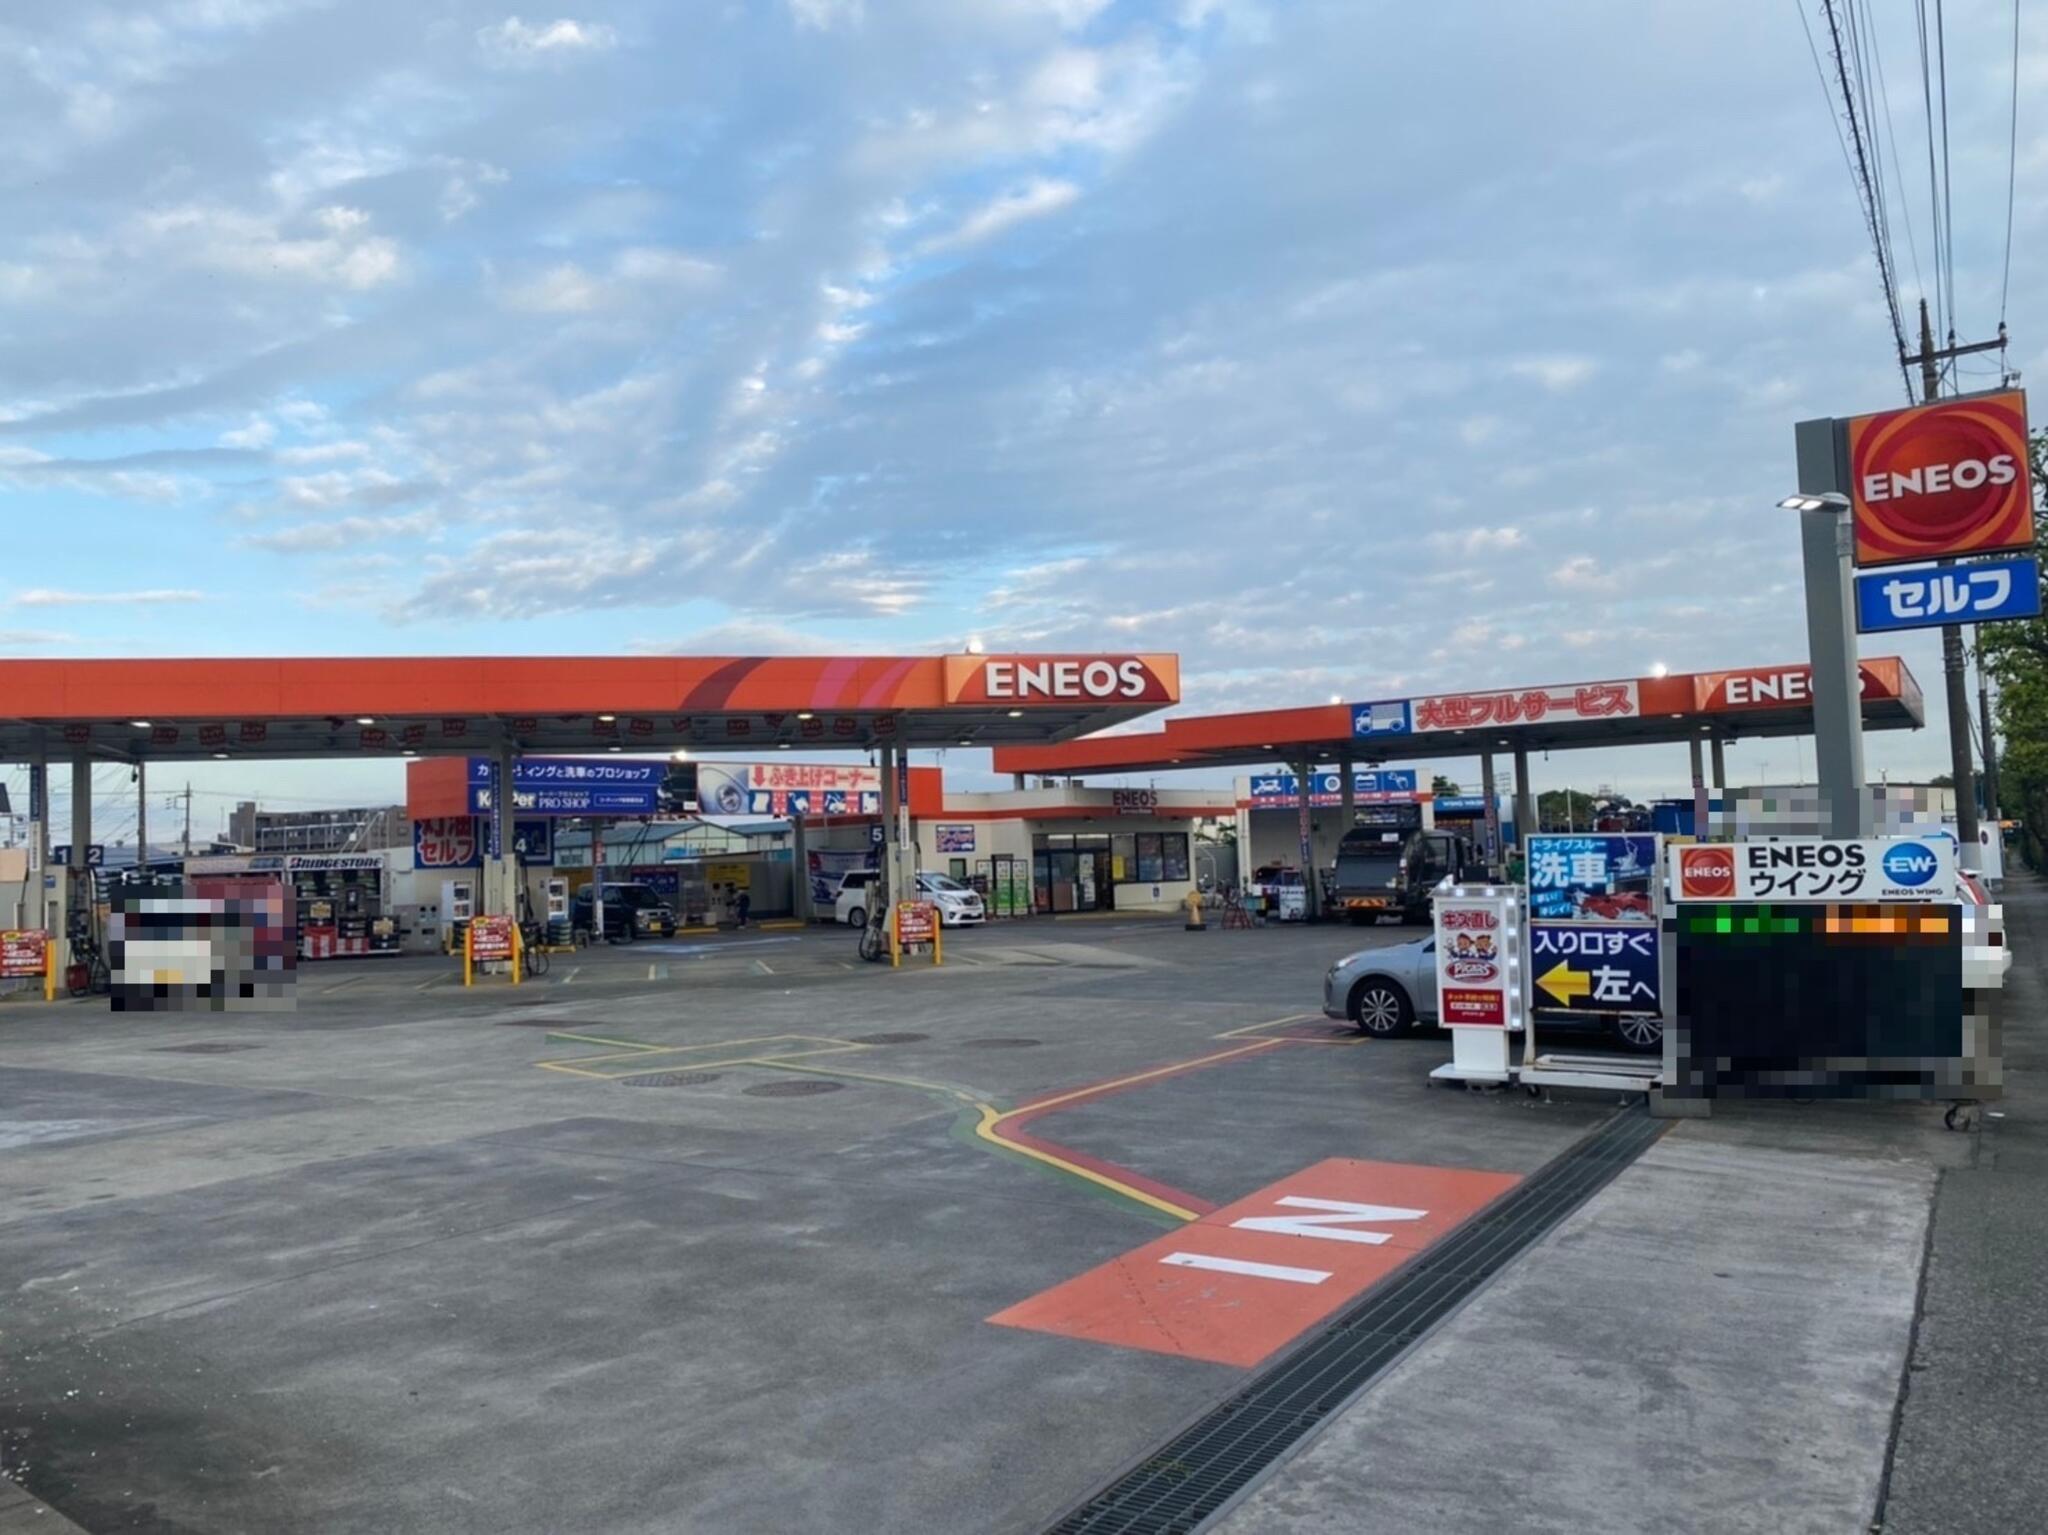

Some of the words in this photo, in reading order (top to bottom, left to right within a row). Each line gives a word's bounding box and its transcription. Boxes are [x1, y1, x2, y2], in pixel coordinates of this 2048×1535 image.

[1863, 454, 2016, 502] ENEOS
[1883, 569, 2011, 618] セルフ
[986, 661, 1146, 697] ENEOS
[1725, 672, 1865, 704] ENE
[1416, 686, 1633, 729] 大型フルサービス
[769, 766, 875, 787] ふき上げコーナー
[539, 797, 560, 809] PRO
[562, 797, 590, 809] SHOP
[1112, 790, 1158, 806] ENEOS
[515, 838, 527, 852] 4
[872, 828, 883, 841] 5
[1531, 840, 1607, 850] ドライブスルー
[58, 850, 68, 863] 1
[88, 850, 100, 863] 2
[290, 857, 382, 869] BRIDGESTONE
[420, 838, 474, 864] セルフ
[1748, 844, 1866, 868] ENEOS
[1531, 851, 1607, 888] 洗車
[1684, 866, 1731, 878] ENEOS
[1890, 856, 1932, 873] EW
[1750, 868, 1867, 897] ウイング
[1534, 930, 1653, 955] 入り口すぐ
[1592, 965, 1656, 1002] 左へ
[1158, 1195, 1430, 1285] IN
